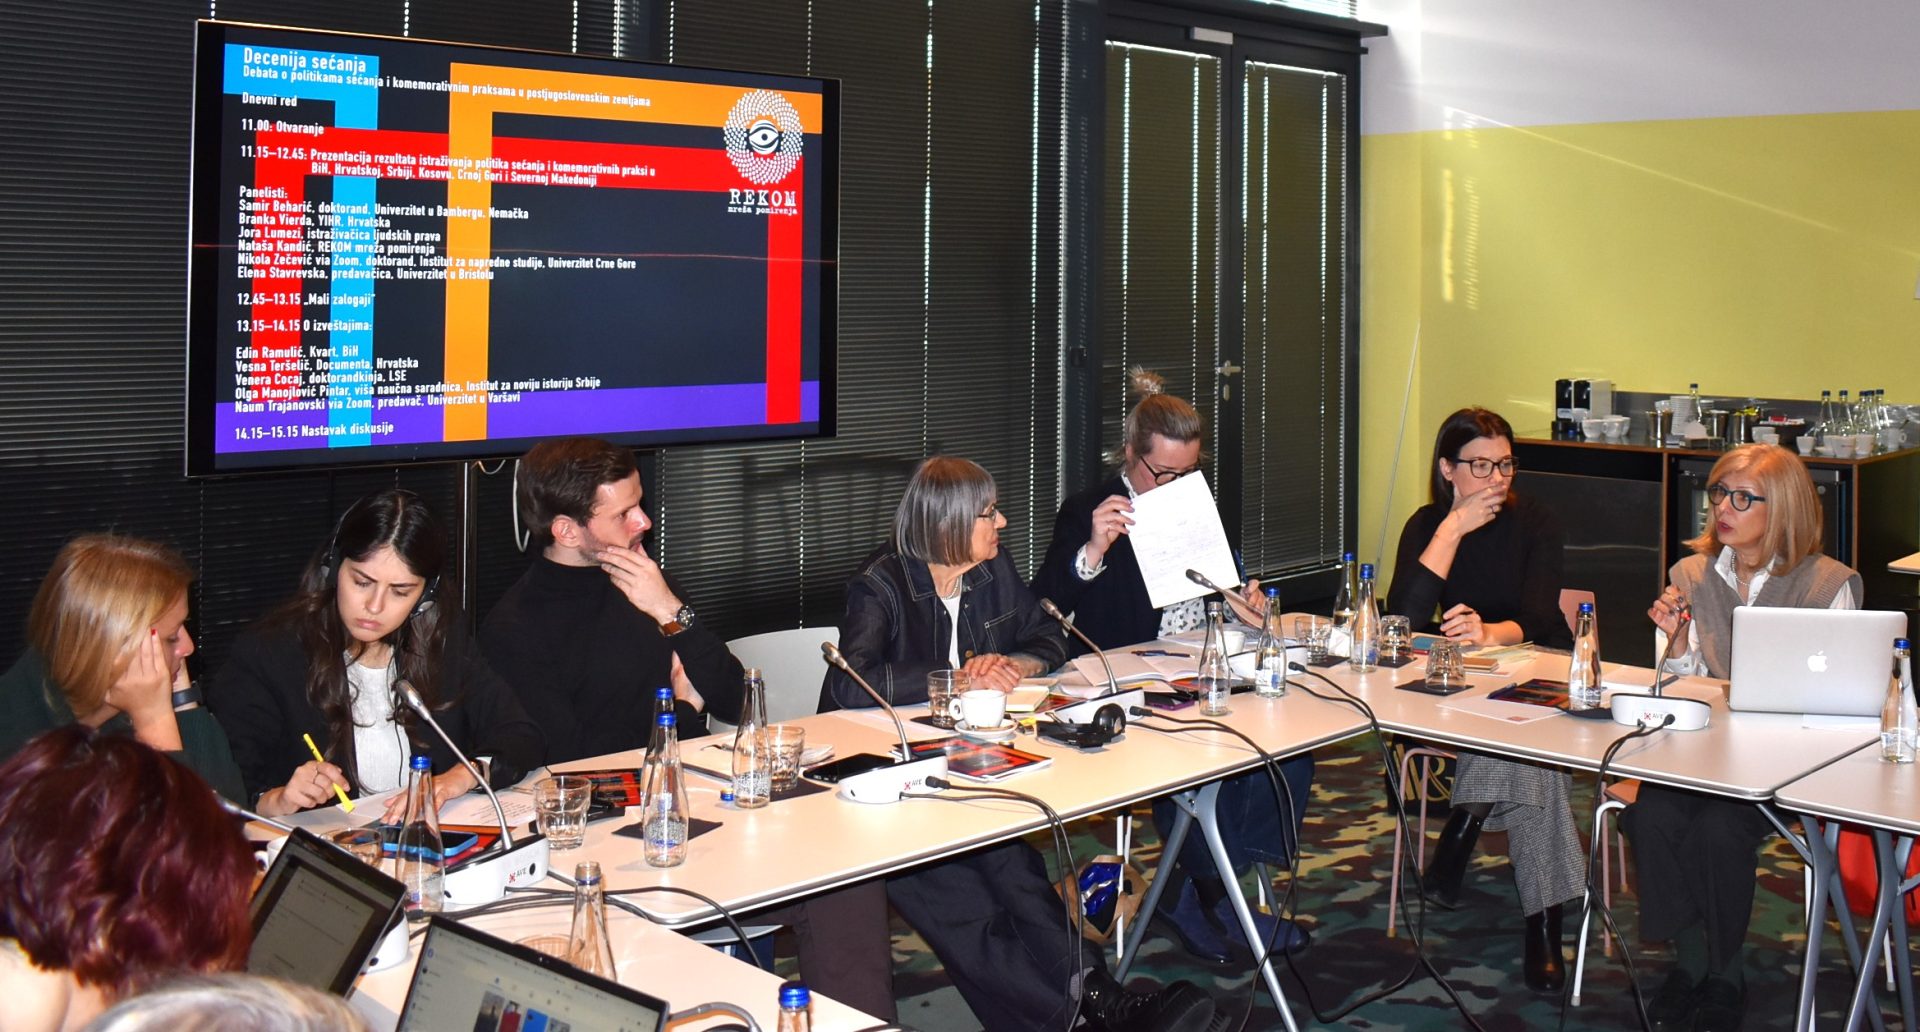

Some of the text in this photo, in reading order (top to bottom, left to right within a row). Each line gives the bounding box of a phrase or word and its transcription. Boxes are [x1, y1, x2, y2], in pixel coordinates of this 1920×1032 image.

[244, 48, 366, 74] Decenija sećanja
[244, 65, 278, 78] Debata
[291, 68, 343, 83] politikama
[346, 73, 384, 88] sećanja
[386, 76, 390, 87] i
[393, 76, 470, 92] komemorativnim
[472, 84, 516, 96] praksama
[526, 89, 610, 103] postjugoslovenskim
[612, 96, 651, 107] zemljama
[242, 92, 297, 106] Dnevni red
[243, 119, 324, 136] 11.00: Otvaranje
[310, 149, 372, 166] Prezentacija
[374, 153, 416, 164] rezultata
[419, 154, 472, 170] istraživanja
[475, 158, 509, 172] politika
[512, 160, 545, 173] sećanja
[548, 161, 551, 170] i
[553, 161, 620, 174] komemorativnih
[622, 165, 648, 177] praksi
[458, 168, 482, 182] Crnoj
[484, 170, 503, 181] Gori
[505, 171, 508, 181] i
[511, 171, 549, 186] Severnoj
[551, 173, 597, 187] Makedoniji
[240, 186, 287, 198] Panelisti:
[729, 188, 796, 206] REKOM
[239, 199, 270, 211] Samir
[374, 204, 426, 216] Univerzitet
[428, 208, 434, 216] u
[488, 207, 529, 219] Nemačka
[756, 207, 798, 216] pomirenja
[239, 213, 276, 224] Branka
[348, 216, 390, 228] Hrvatska
[238, 226, 261, 238] Jora
[307, 227, 370, 240] istraživačica
[373, 229, 412, 243] ljudskih
[414, 233, 441, 244] prava
[238, 240, 274, 251] Nataša
[318, 242, 352, 252] REKOM
[355, 242, 385, 253] mreža
[387, 243, 435, 256] pomirenja
[238, 253, 271, 264] Nikola
[274, 253, 312, 265] Zečević
[315, 254, 330, 265] via
[420, 254, 453, 267] Institut
[455, 258, 466, 267] za
[468, 256, 511, 270] napredne
[548, 257, 594, 268] Univerzitet
[596, 258, 615, 268] Crne
[617, 258, 636, 268] Gore
[238, 266, 266, 278] Elena
[397, 267, 448, 279] Univerzitet
[458, 268, 494, 280] Bristolu
[303, 320, 310, 331] O
[313, 320, 372, 332] izveštajima:
[236, 347, 259, 359] Edin
[342, 346, 358, 356] BiH
[236, 360, 267, 372] Vesna
[376, 357, 418, 368] Hrvatska
[236, 374, 272, 385] Venera
[389, 370, 406, 381] LSE
[235, 387, 259, 402] Olga
[262, 385, 316, 401] Manojlović
[355, 383, 375, 394] viša
[377, 383, 412, 394] naučna
[466, 380, 499, 391] Institut
[500, 382, 511, 390] za
[513, 379, 540, 392] noviju
[542, 378, 573, 390] istoriju
[576, 377, 600, 389] Srbije
[235, 400, 264, 412] Naum
[268, 398, 325, 413] Trajanovski
[427, 394, 478, 405] Univerzitet
[488, 391, 520, 403] Varšavi
[301, 424, 346, 436] Nastavak
[350, 422, 394, 435] diskusije
